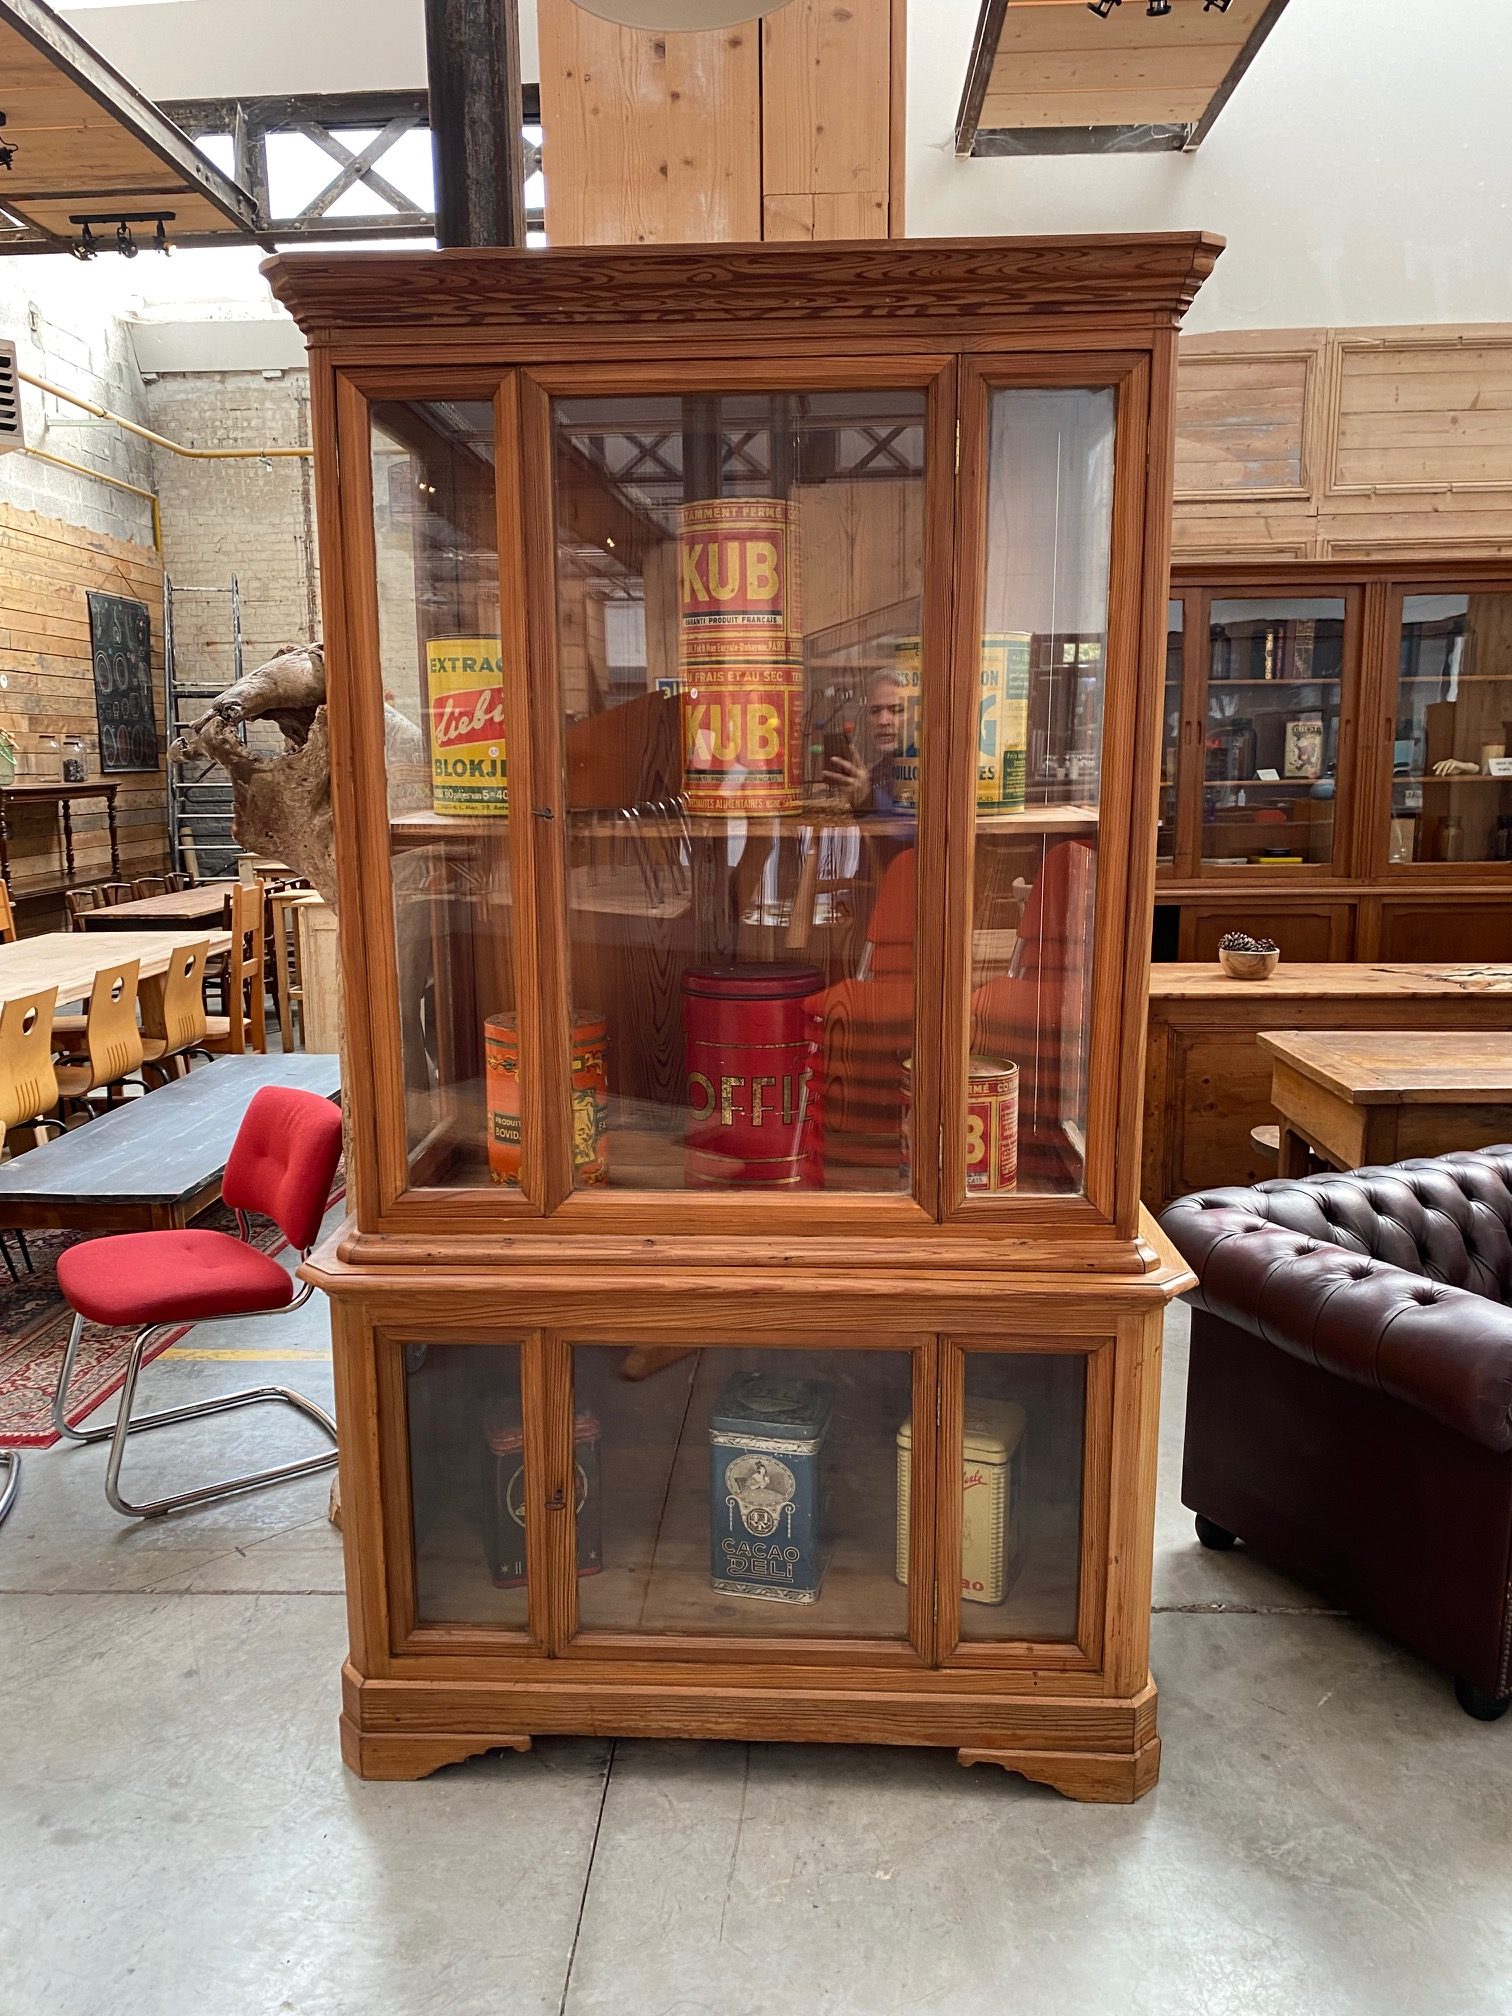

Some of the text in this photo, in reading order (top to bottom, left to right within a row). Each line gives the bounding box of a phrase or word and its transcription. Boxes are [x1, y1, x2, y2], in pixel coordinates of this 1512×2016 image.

[683, 541, 779, 603] KUB
[708, 616, 738, 624] PRODUIT
[695, 672, 724, 682] FRAIS
[727, 671, 741, 681] ET
[743, 671, 760, 681] AU
[763, 671, 782, 682] SEC
[685, 703, 780, 761] KUB
[495, 1127, 521, 1140] BOVID
[721, 1537, 800, 1563] CACAO
